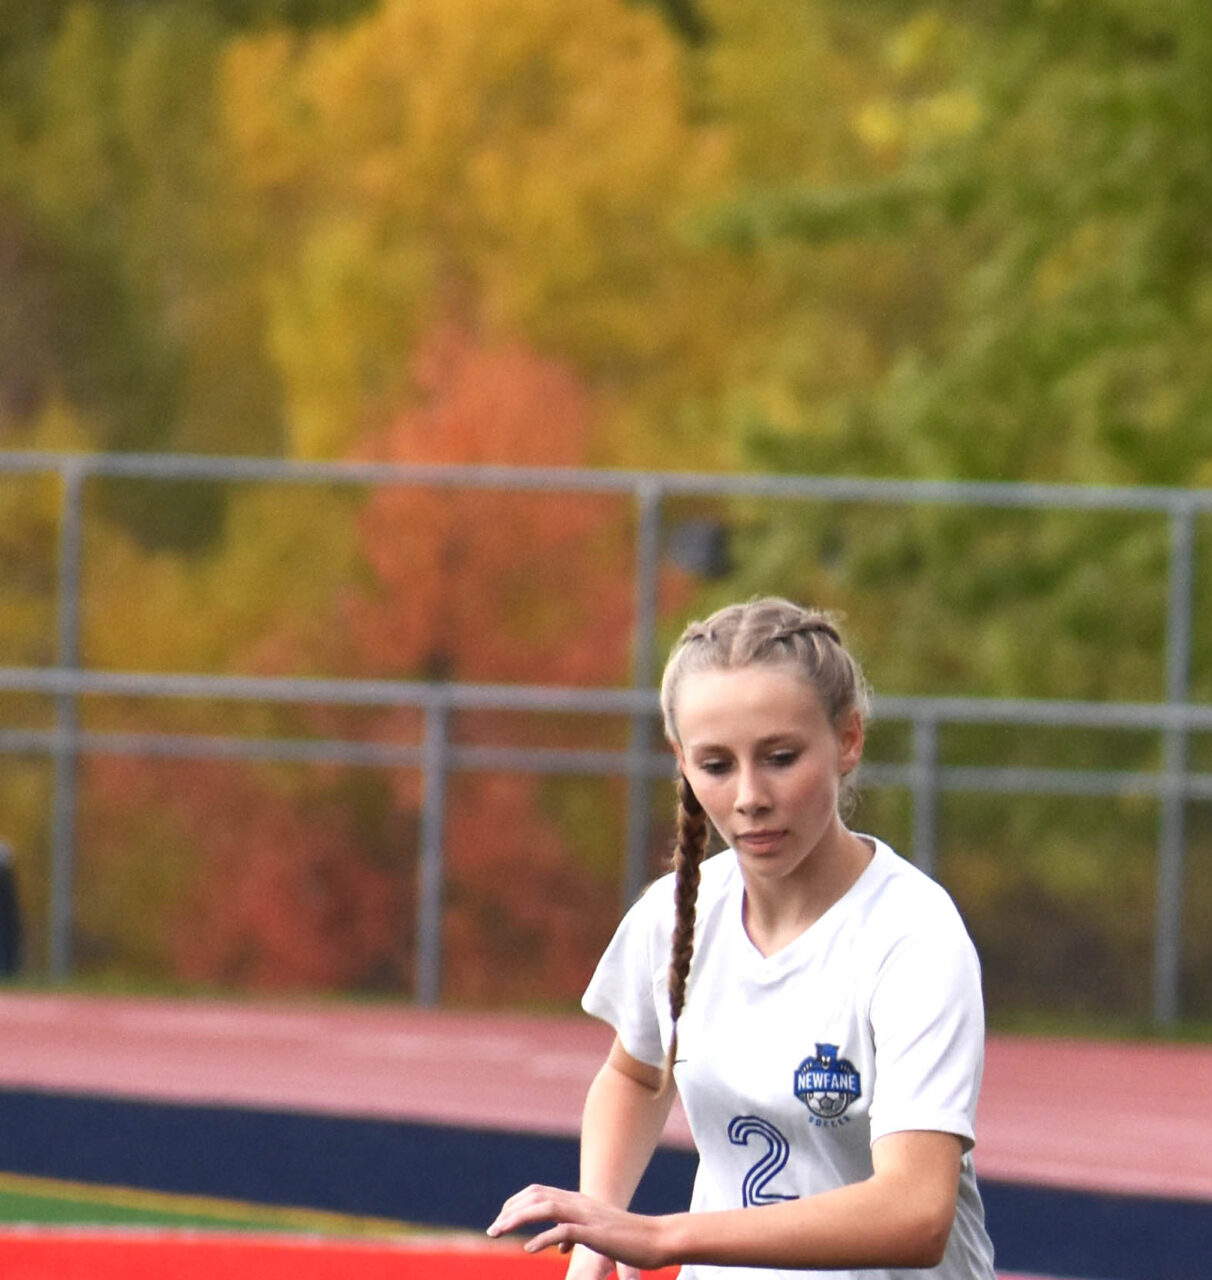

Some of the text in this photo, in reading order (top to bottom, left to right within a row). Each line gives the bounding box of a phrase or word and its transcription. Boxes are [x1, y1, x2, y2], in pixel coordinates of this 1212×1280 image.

[797, 1071, 857, 1091] NEWFANE
[808, 1115, 851, 1128] SOCCER
[727, 1114, 800, 1209] 2
